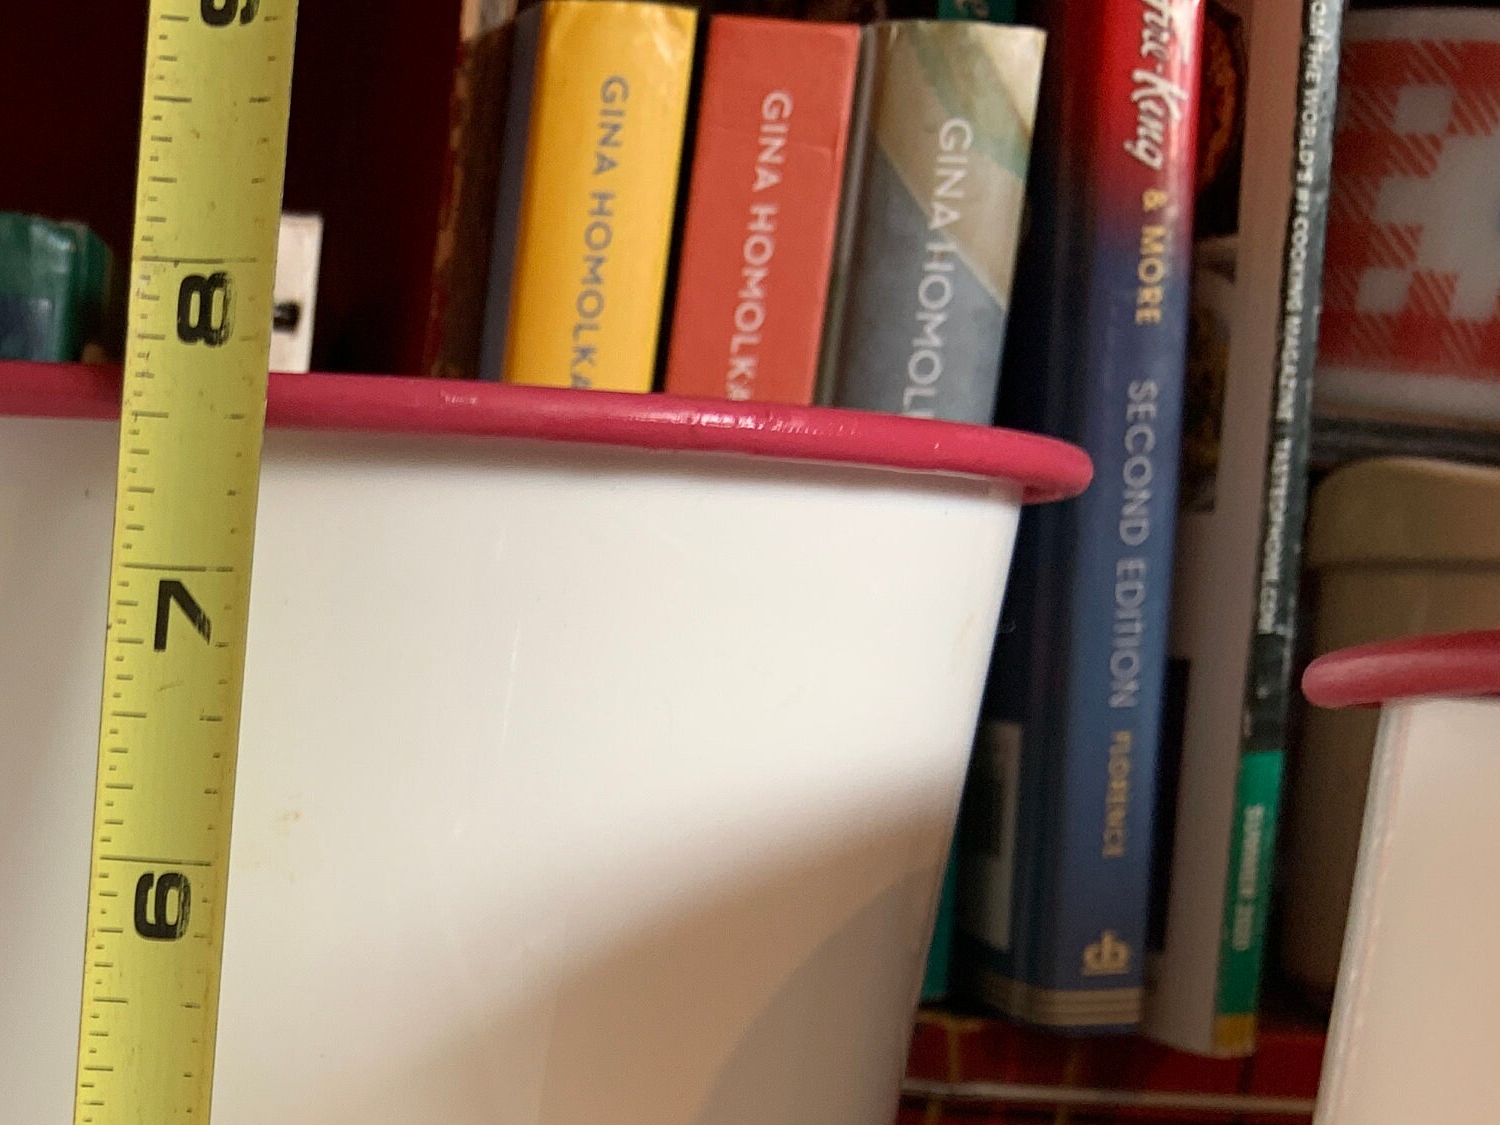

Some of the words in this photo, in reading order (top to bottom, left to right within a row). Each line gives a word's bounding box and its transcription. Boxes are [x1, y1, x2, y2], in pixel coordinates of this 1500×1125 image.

[591, 74, 631, 178] GINA
[751, 89, 794, 193] GINA
[926, 116, 974, 231] GINA
[1141, 188, 1169, 213] &
[176, 271, 233, 348] 8
[1134, 224, 1166, 325] MORE
[901, 241, 960, 419] HOMOL
[1118, 378, 1159, 548] SECOND
[152, 579, 212, 653] 7
[1108, 556, 1148, 708] EDITION
[133, 870, 192, 942] 6
